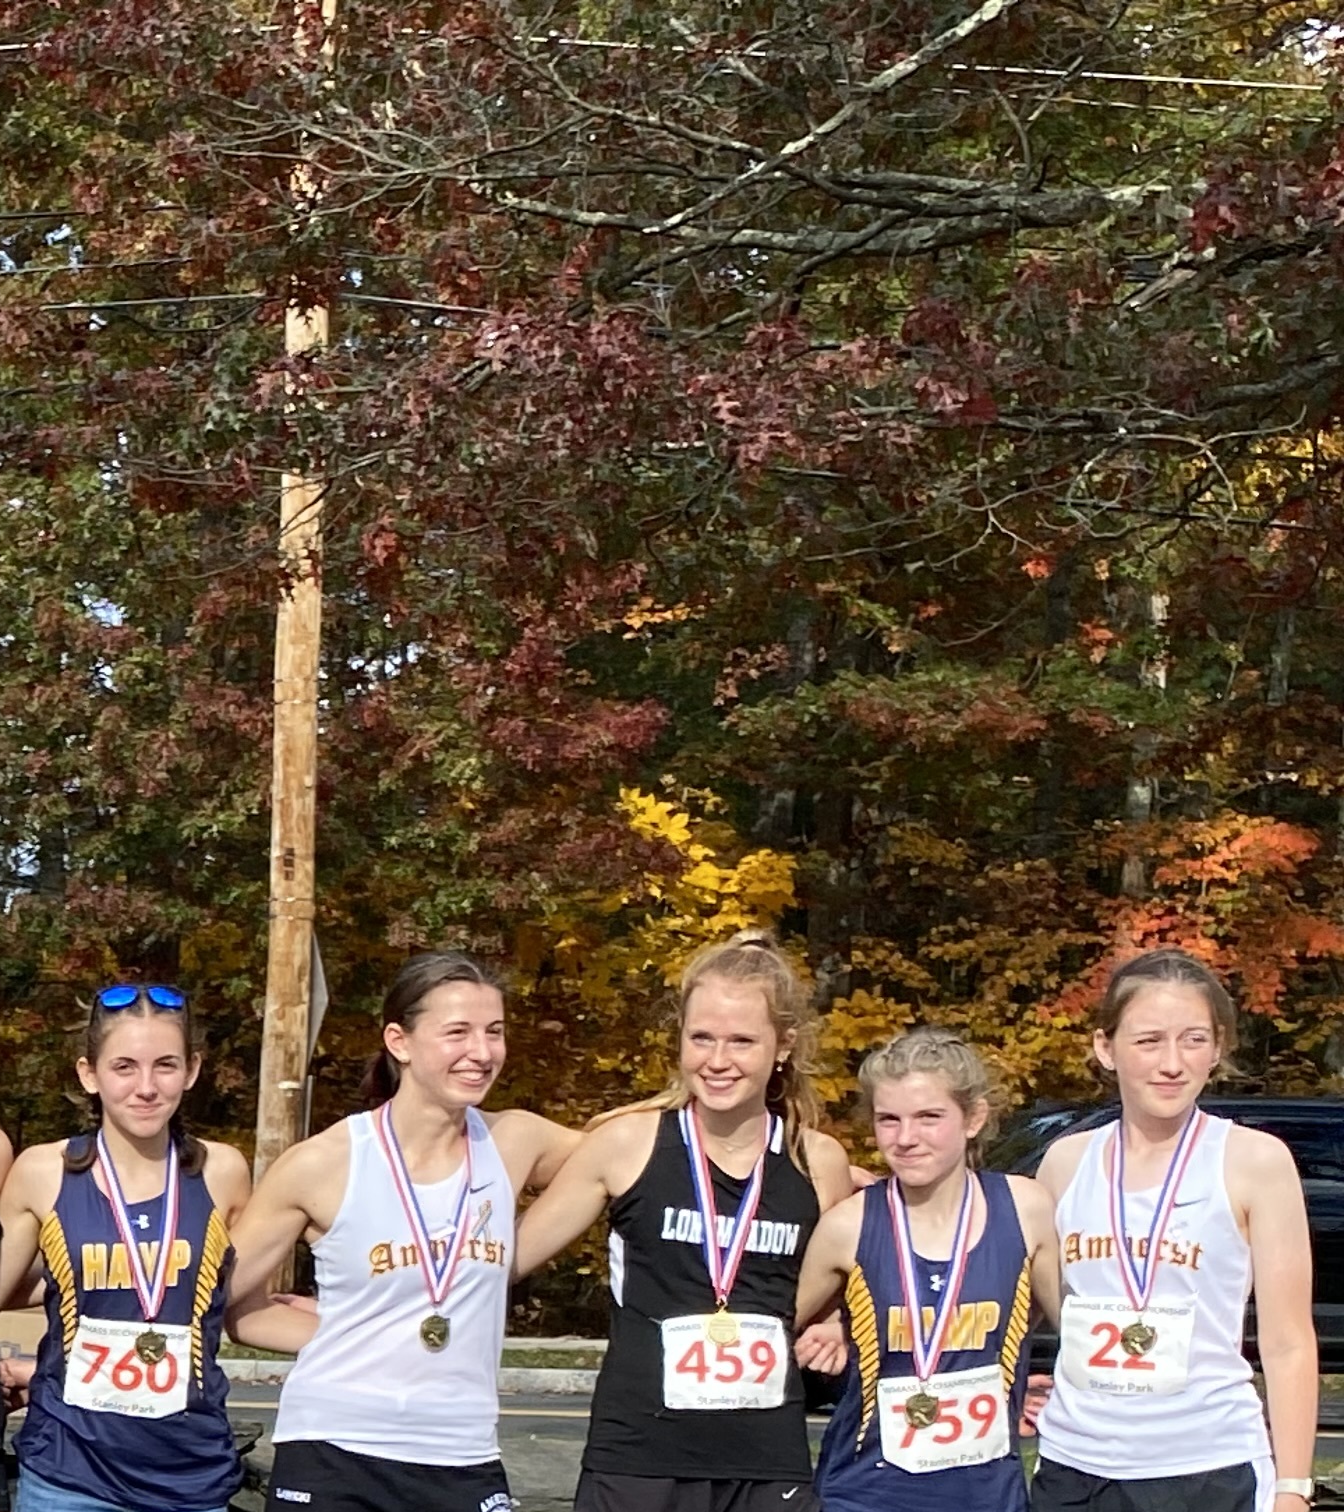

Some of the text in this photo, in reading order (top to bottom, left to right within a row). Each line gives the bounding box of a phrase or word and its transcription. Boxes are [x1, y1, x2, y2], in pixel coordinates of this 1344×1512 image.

[661, 1206, 800, 1256] LONMADOW
[887, 1300, 1001, 1352] HMP
[81, 1341, 178, 1394] 760
[675, 1340, 777, 1384] 459
[891, 1393, 998, 1449] 759
